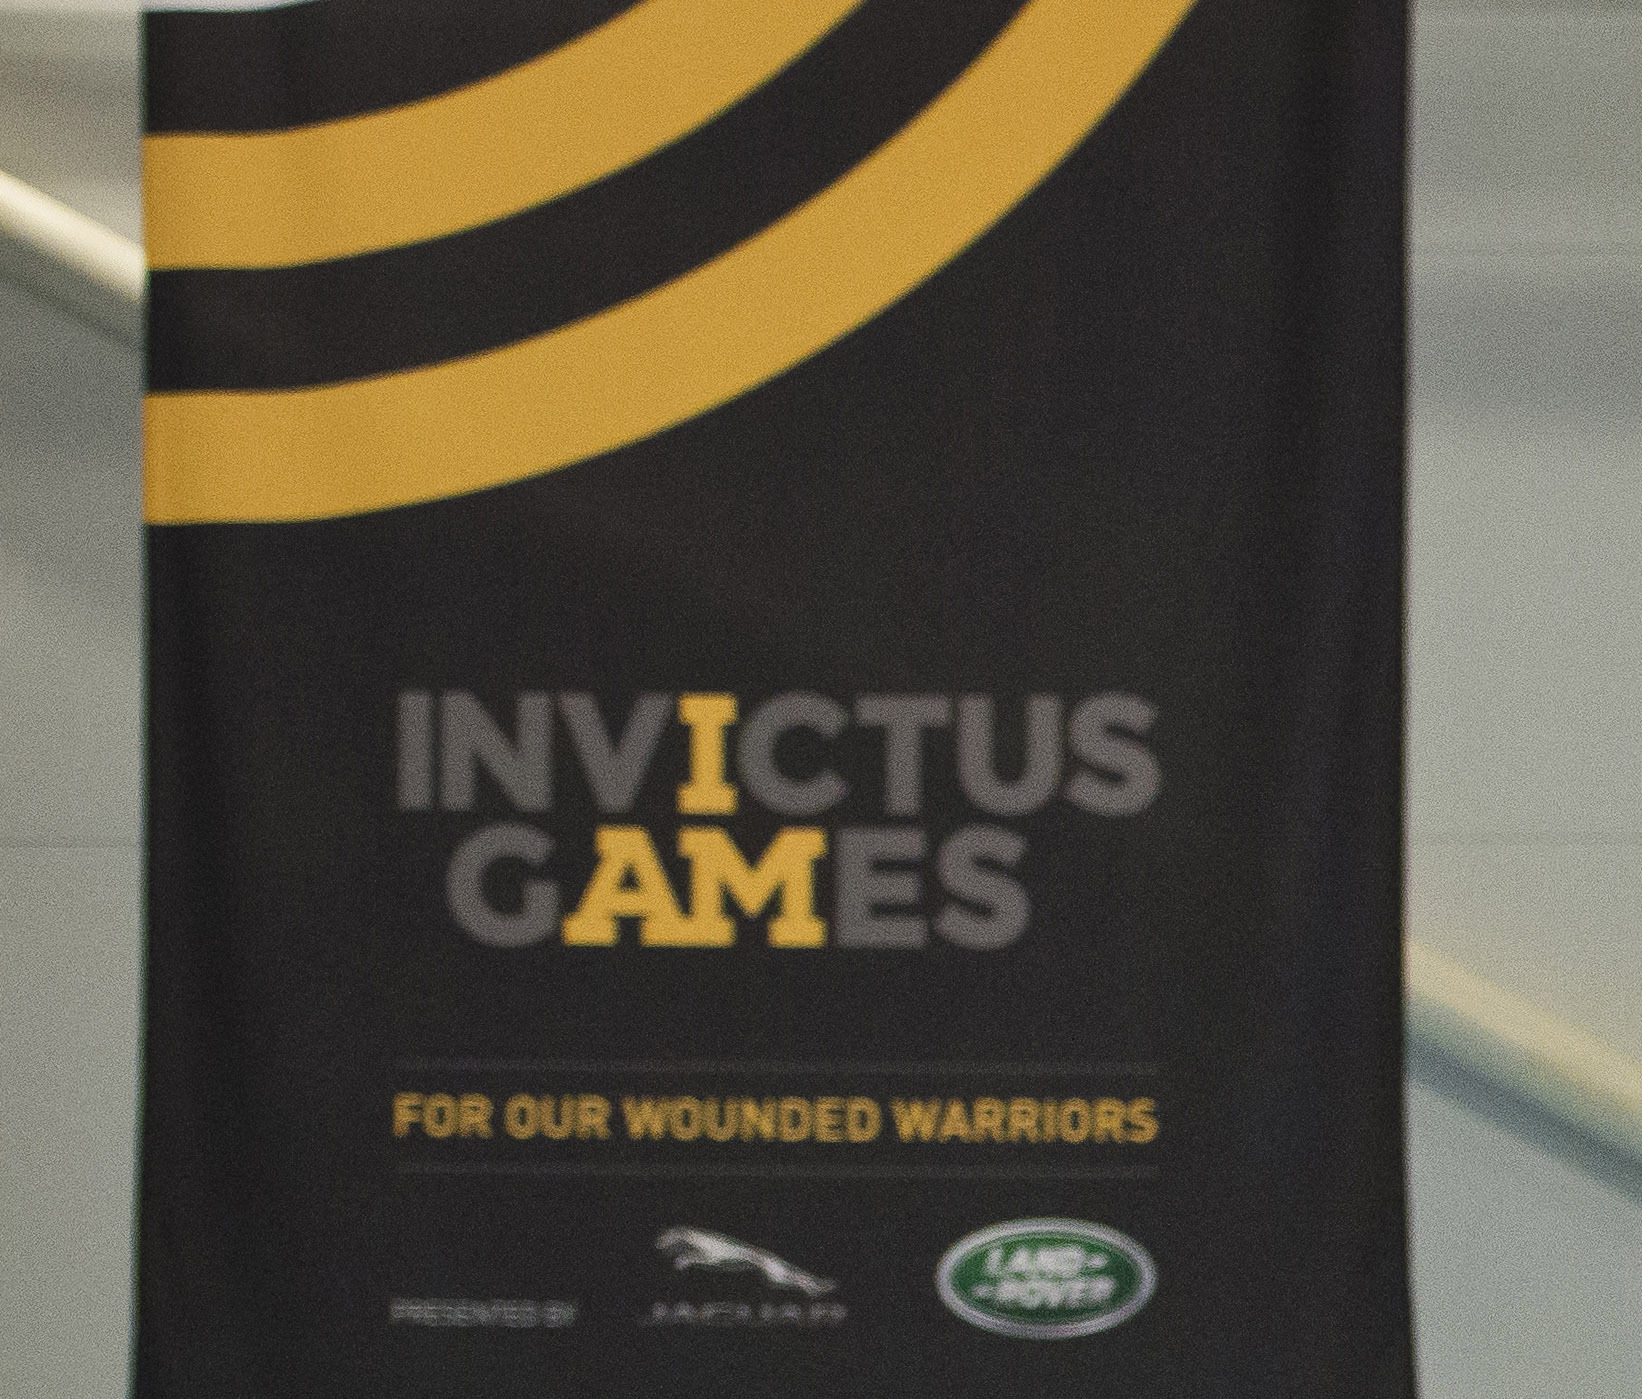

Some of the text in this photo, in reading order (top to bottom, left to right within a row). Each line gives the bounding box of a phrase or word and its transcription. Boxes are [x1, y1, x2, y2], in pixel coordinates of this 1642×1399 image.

[398, 689, 1163, 815] INVICTUS
[445, 822, 1033, 948] GAMES
[393, 1092, 1160, 1143] FOR OUR WOUNDED WARRIORS
